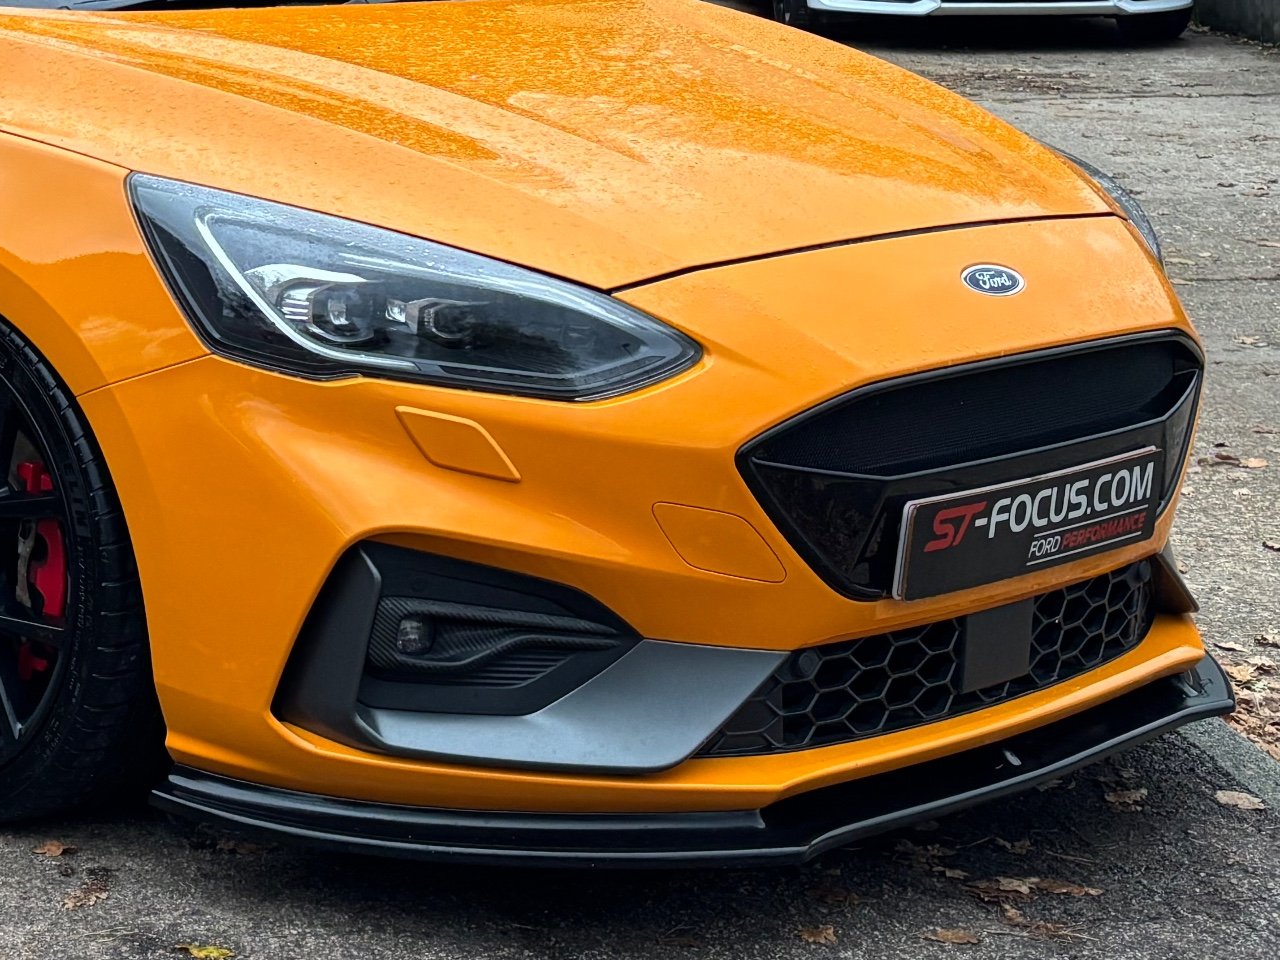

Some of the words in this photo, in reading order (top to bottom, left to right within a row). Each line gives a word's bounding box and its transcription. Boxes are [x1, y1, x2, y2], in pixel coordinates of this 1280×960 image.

[975, 271, 1012, 290] Ford
[923, 461, 1155, 553] ST-FOCUS.COM
[1028, 535, 1061, 558] FORD
[1061, 511, 1147, 549] PERFORMANCE
